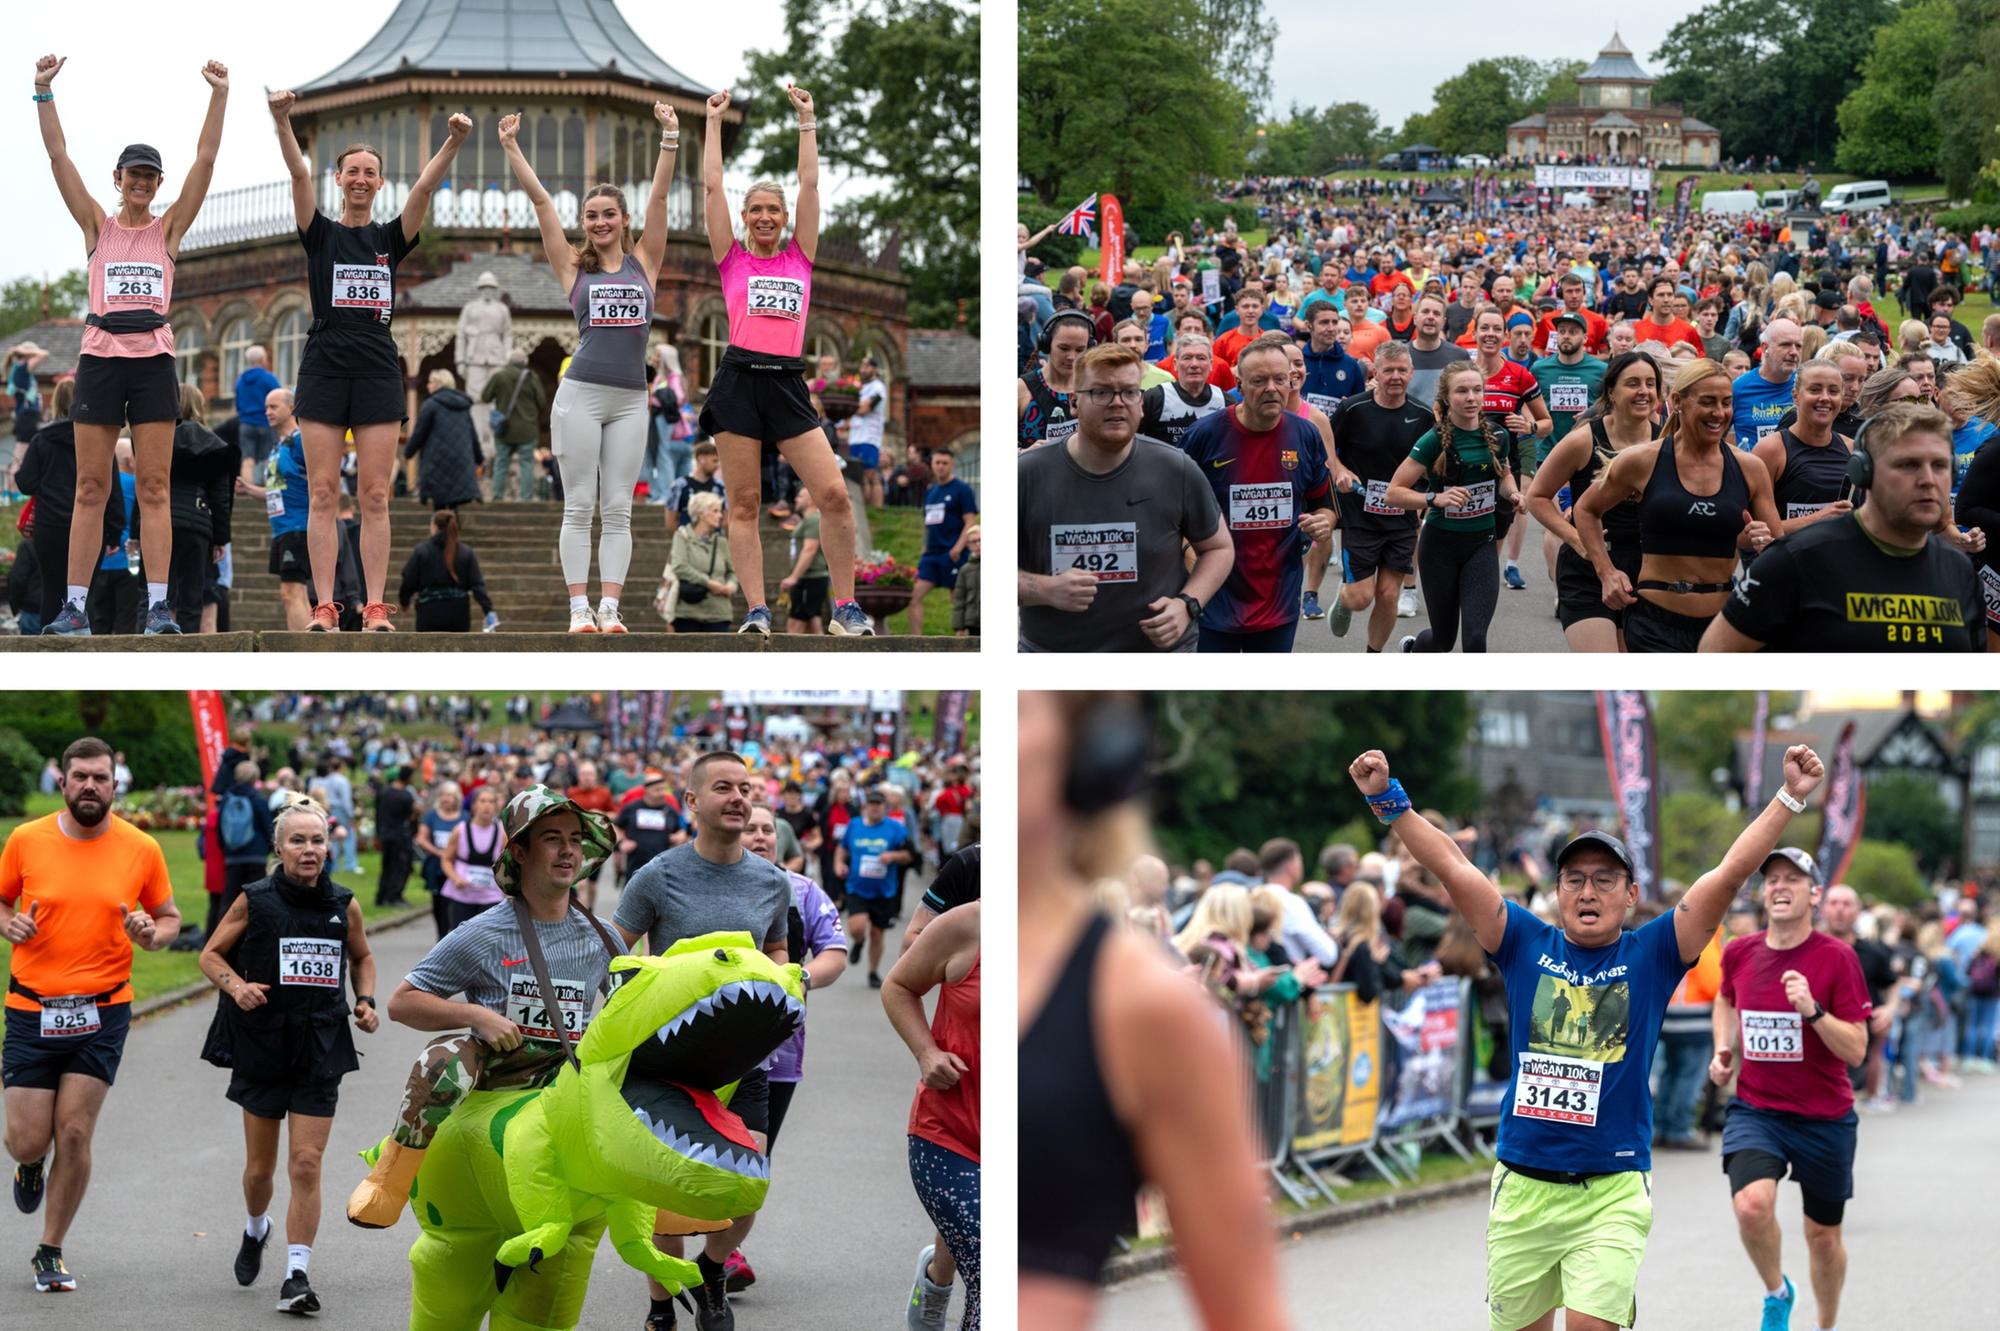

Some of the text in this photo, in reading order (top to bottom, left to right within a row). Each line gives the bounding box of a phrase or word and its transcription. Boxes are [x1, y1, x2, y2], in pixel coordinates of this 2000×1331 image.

[1574, 171, 1611, 183] FINISH
[115, 267, 156, 276] WIGAN 10K
[343, 271, 384, 280] WIGAN 10K
[119, 282, 152, 295] 263
[347, 285, 380, 299] 836
[757, 281, 798, 292] WIGAN 10K
[599, 290, 639, 298] WIGAN 10K
[755, 294, 797, 312] 2213
[598, 305, 639, 318] 1879
[1499, 399, 1513, 408] Tri
[1560, 397, 1580, 406] 219
[1240, 488, 1284, 499] WIGAN 10K
[1245, 505, 1279, 520] 491
[1688, 502, 1717, 516] ARC
[1065, 531, 1124, 544] WIGAN 10K
[1072, 553, 1119, 571] 492
[1850, 596, 1961, 623] WIGAN 10K
[1887, 624, 1943, 643] 2024
[290, 944, 334, 955] WIGAN 10K
[289, 960, 333, 977] 1638
[561, 988, 577, 1000] 10K
[54, 1012, 87, 1029] 925
[519, 1006, 576, 1030] 143
[1749, 1035, 1795, 1051] 1013
[1531, 1061, 1588, 1081] WIGAN 10K
[1526, 1085, 1588, 1112] 3143
